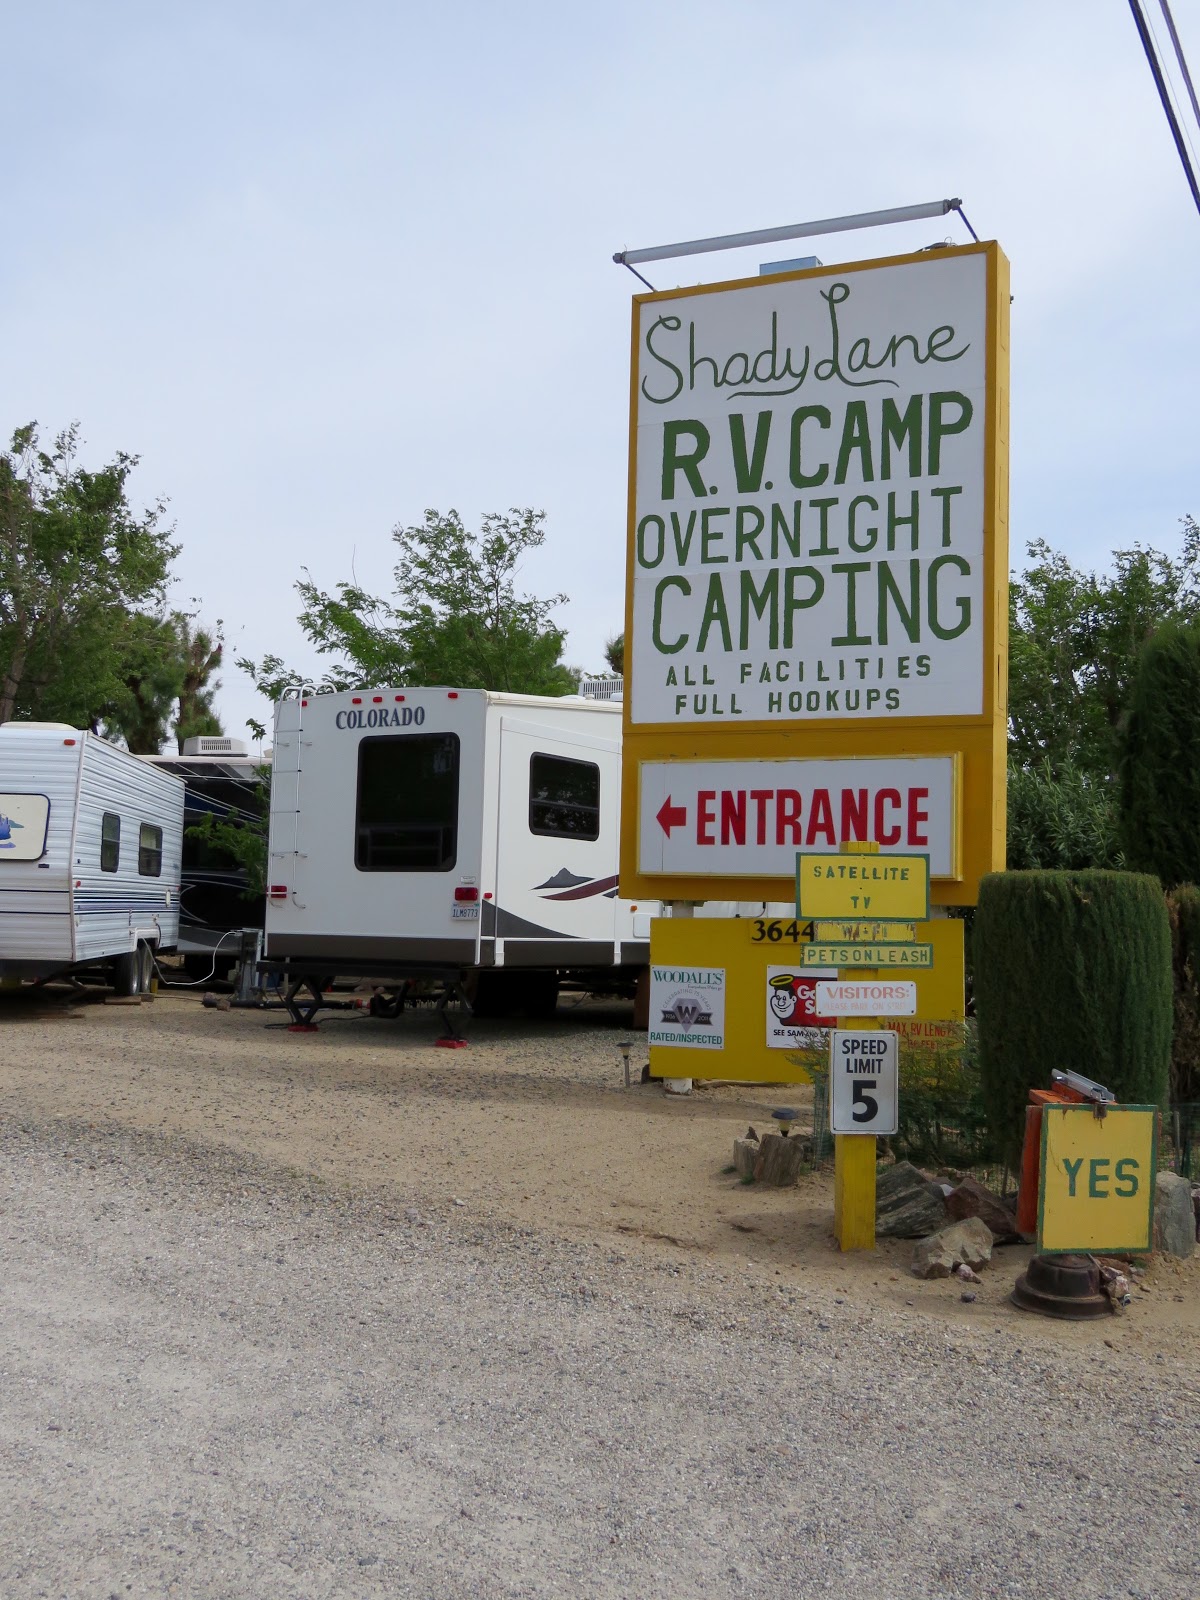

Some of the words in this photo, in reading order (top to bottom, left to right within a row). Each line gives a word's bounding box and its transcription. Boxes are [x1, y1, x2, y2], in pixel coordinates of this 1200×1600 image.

[641, 311, 809, 404] Shady
[813, 282, 971, 388] Lane
[661, 411, 773, 500] R.V.
[789, 391, 973, 489] CAMP
[637, 486, 963, 569] OVERNIGHT
[652, 554, 972, 655] CAMPING
[666, 664, 715, 686] ALL
[741, 654, 931, 683] FACILITIES
[675, 693, 742, 715] FULL
[768, 688, 900, 713] HOOKUPS
[335, 706, 426, 730] COLORADO
[696, 787, 929, 846] ENTRANCE
[813, 865, 910, 881] SATELLITE
[850, 896, 871, 910] TV
[751, 919, 815, 943] 3644
[807, 949, 849, 962] PETS
[852, 949, 873, 962] ON
[877, 949, 928, 963] LEASH
[653, 970, 723, 986] WOODALL'S
[826, 986, 910, 1000] VISITORS:
[650, 1031, 723, 1045] RATED/INSPECTED
[886, 1022, 907, 1037] MAX
[842, 1038, 888, 1055] SPEED
[846, 1058, 883, 1074] LIMIT
[852, 1080, 879, 1123] 5
[1062, 1157, 1140, 1198] YES
